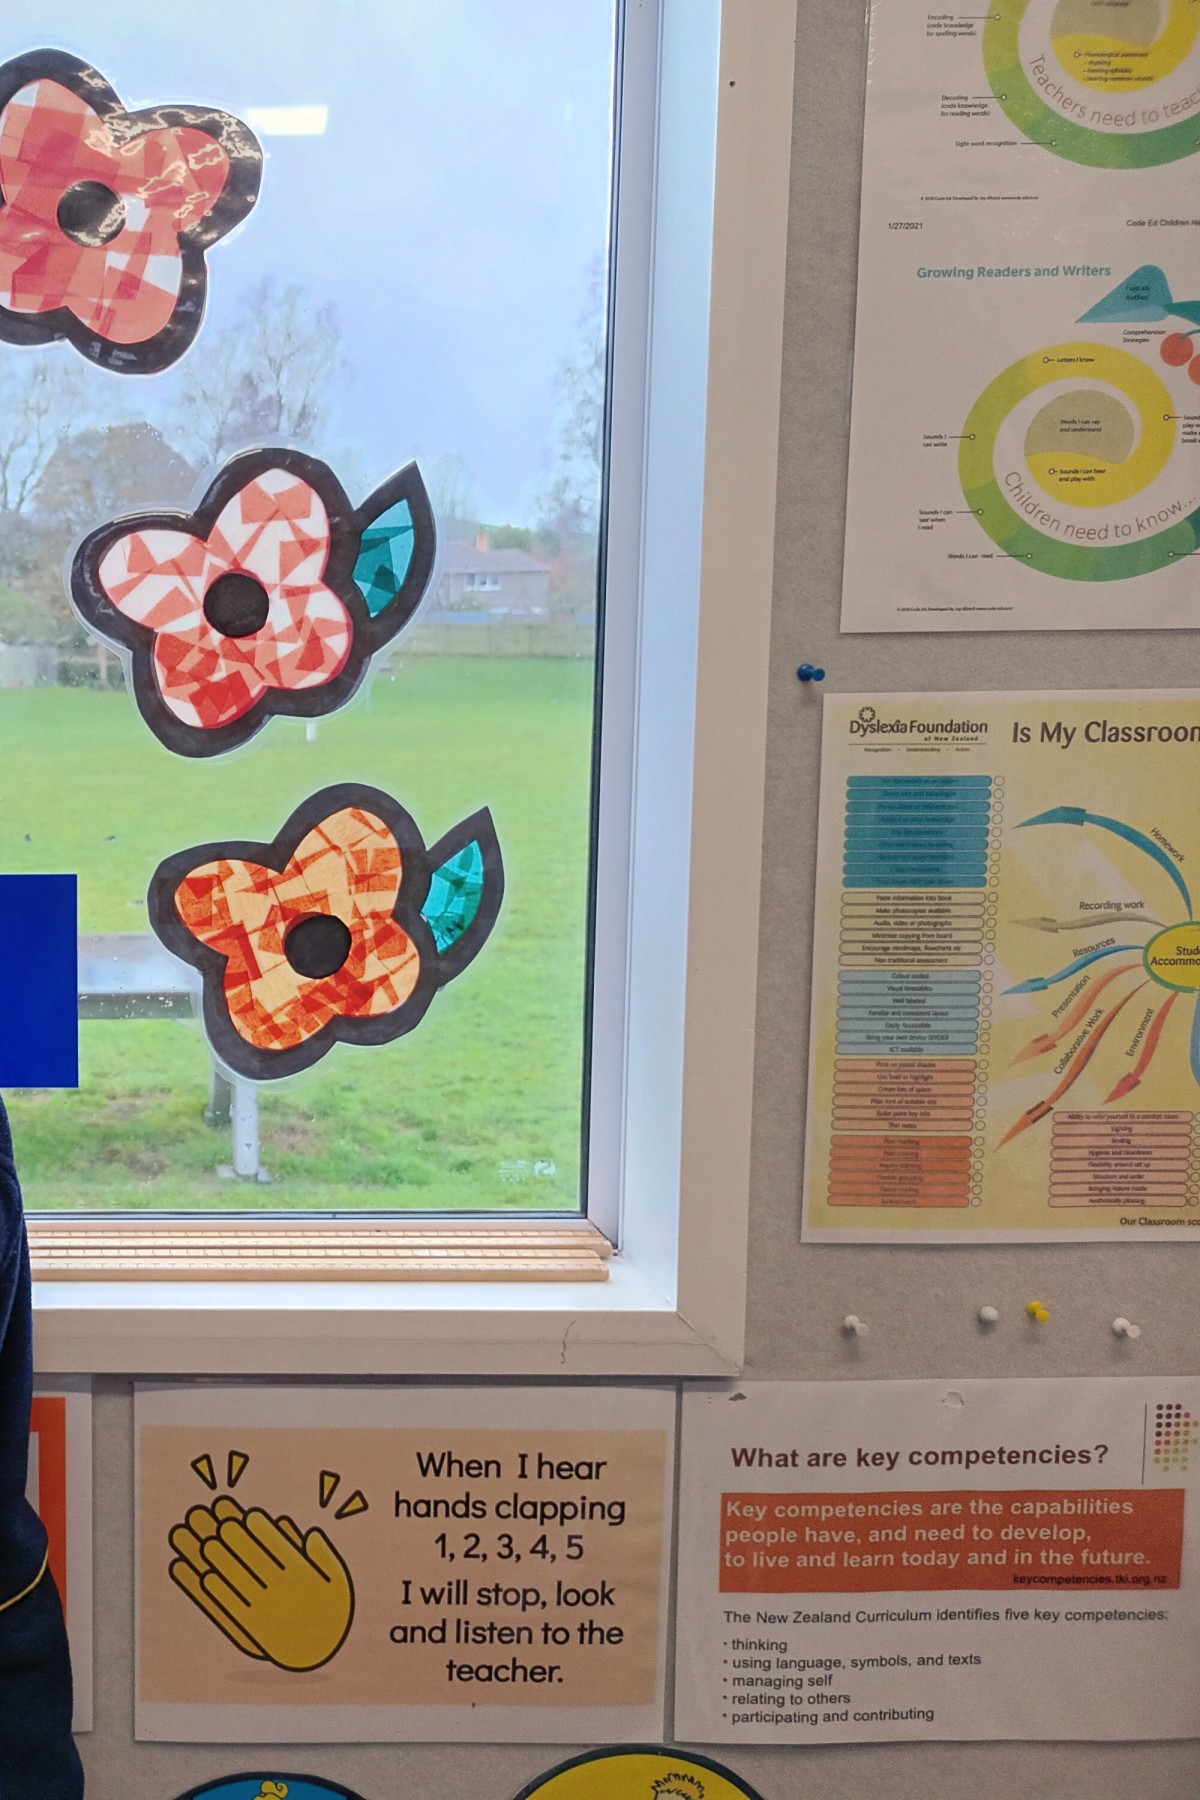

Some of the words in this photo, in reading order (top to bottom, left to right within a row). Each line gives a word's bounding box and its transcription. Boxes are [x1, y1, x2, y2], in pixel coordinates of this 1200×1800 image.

[935, 30, 957, 38] spelling
[1029, 53, 1087, 119] Teachers
[1090, 110, 1136, 127] need
[1142, 109, 1159, 125] to
[888, 222, 923, 230] 1/27/2021
[1126, 219, 1146, 227] Code
[1148, 219, 1158, 227] Ed
[917, 267, 974, 280] Growing
[977, 266, 1031, 278] Readers
[1034, 265, 1059, 277] and
[1063, 265, 1112, 277] Writers
[1123, 329, 1166, 337] Comprehension
[1005, 471, 1061, 532] Children
[1064, 524, 1109, 540] need
[1114, 524, 1132, 538] to
[909, 719, 988, 734] Foundation
[1012, 722, 1031, 743] Is
[1040, 721, 1077, 749] My
[1150, 827, 1186, 863] Homework
[1079, 900, 1122, 912] Recording
[1124, 900, 1145, 910] work
[917, 920, 952, 928] photographs
[898, 932, 921, 940] copying
[1072, 937, 1116, 958] Resources
[1176, 945, 1200, 956] Stud
[1051, 974, 1090, 1019] Presentation
[1054, 1028, 1089, 1075] Collaborative
[1086, 1008, 1104, 1029] Work
[1125, 1008, 1154, 1057] Environment
[1120, 1217, 1137, 1226] Our
[1138, 1217, 1185, 1226] Classroom
[416, 1450, 501, 1478] When
[518, 1453, 528, 1479] I
[537, 1452, 607, 1480] hear
[731, 1447, 799, 1468] What
[807, 1451, 847, 1468] are
[856, 1448, 900, 1471] key
[908, 1444, 1109, 1470] competencies?
[394, 1490, 487, 1519] hands
[495, 1492, 626, 1527] clapping
[726, 1501, 767, 1522] Key
[774, 1500, 923, 1522] competencies
[930, 1502, 963, 1516] are
[969, 1499, 1004, 1515] the
[1010, 1497, 1134, 1518] capabilities
[725, 1527, 797, 1547] people
[804, 1527, 862, 1545] have,
[868, 1525, 907, 1543] and
[914, 1524, 965, 1542] need
[972, 1525, 993, 1541] to
[1000, 1524, 1091, 1544] develop,
[434, 1532, 455, 1563] 1,
[463, 1532, 488, 1563] 2,
[496, 1533, 521, 1563] 3,
[529, 1534, 556, 1564] 4,
[565, 1534, 584, 1560] 5
[724, 1552, 745, 1567] to
[752, 1551, 789, 1568] live
[796, 1552, 836, 1568] and
[843, 1551, 894, 1568] learn
[902, 1549, 960, 1568] today
[967, 1549, 1007, 1565] and
[1014, 1550, 1033, 1565] in
[1040, 1549, 1074, 1565] the
[1081, 1549, 1150, 1565] future.
[401, 1580, 412, 1605] I
[420, 1579, 468, 1605] will
[476, 1582, 547, 1612] stop,
[556, 1580, 616, 1607] look
[723, 1611, 751, 1624] The
[756, 1611, 789, 1624] New
[793, 1611, 851, 1624] Zealand
[856, 1609, 932, 1623] Curriculum
[936, 1608, 1000, 1621] identifies
[1005, 1608, 1029, 1620] five
[1034, 1608, 1060, 1623] key
[1065, 1608, 1168, 1624] competencies:
[389, 1618, 447, 1644] and
[455, 1618, 533, 1645] listen
[541, 1622, 570, 1645] to
[577, 1619, 624, 1645] the
[732, 1638, 788, 1653] thinking
[446, 1657, 564, 1683] teacher.
[732, 1657, 771, 1671] using
[776, 1657, 846, 1671] language,
[850, 1655, 912, 1670] symbols,
[917, 1654, 944, 1666] and
[948, 1654, 982, 1666] texts
[732, 1675, 803, 1690] managing
[807, 1674, 833, 1687] self
[732, 1693, 785, 1708] relating
[790, 1694, 803, 1705] to
[807, 1693, 851, 1705] others
[732, 1711, 818, 1726] participating
[822, 1710, 848, 1722] and
[853, 1708, 934, 1722] contributing
